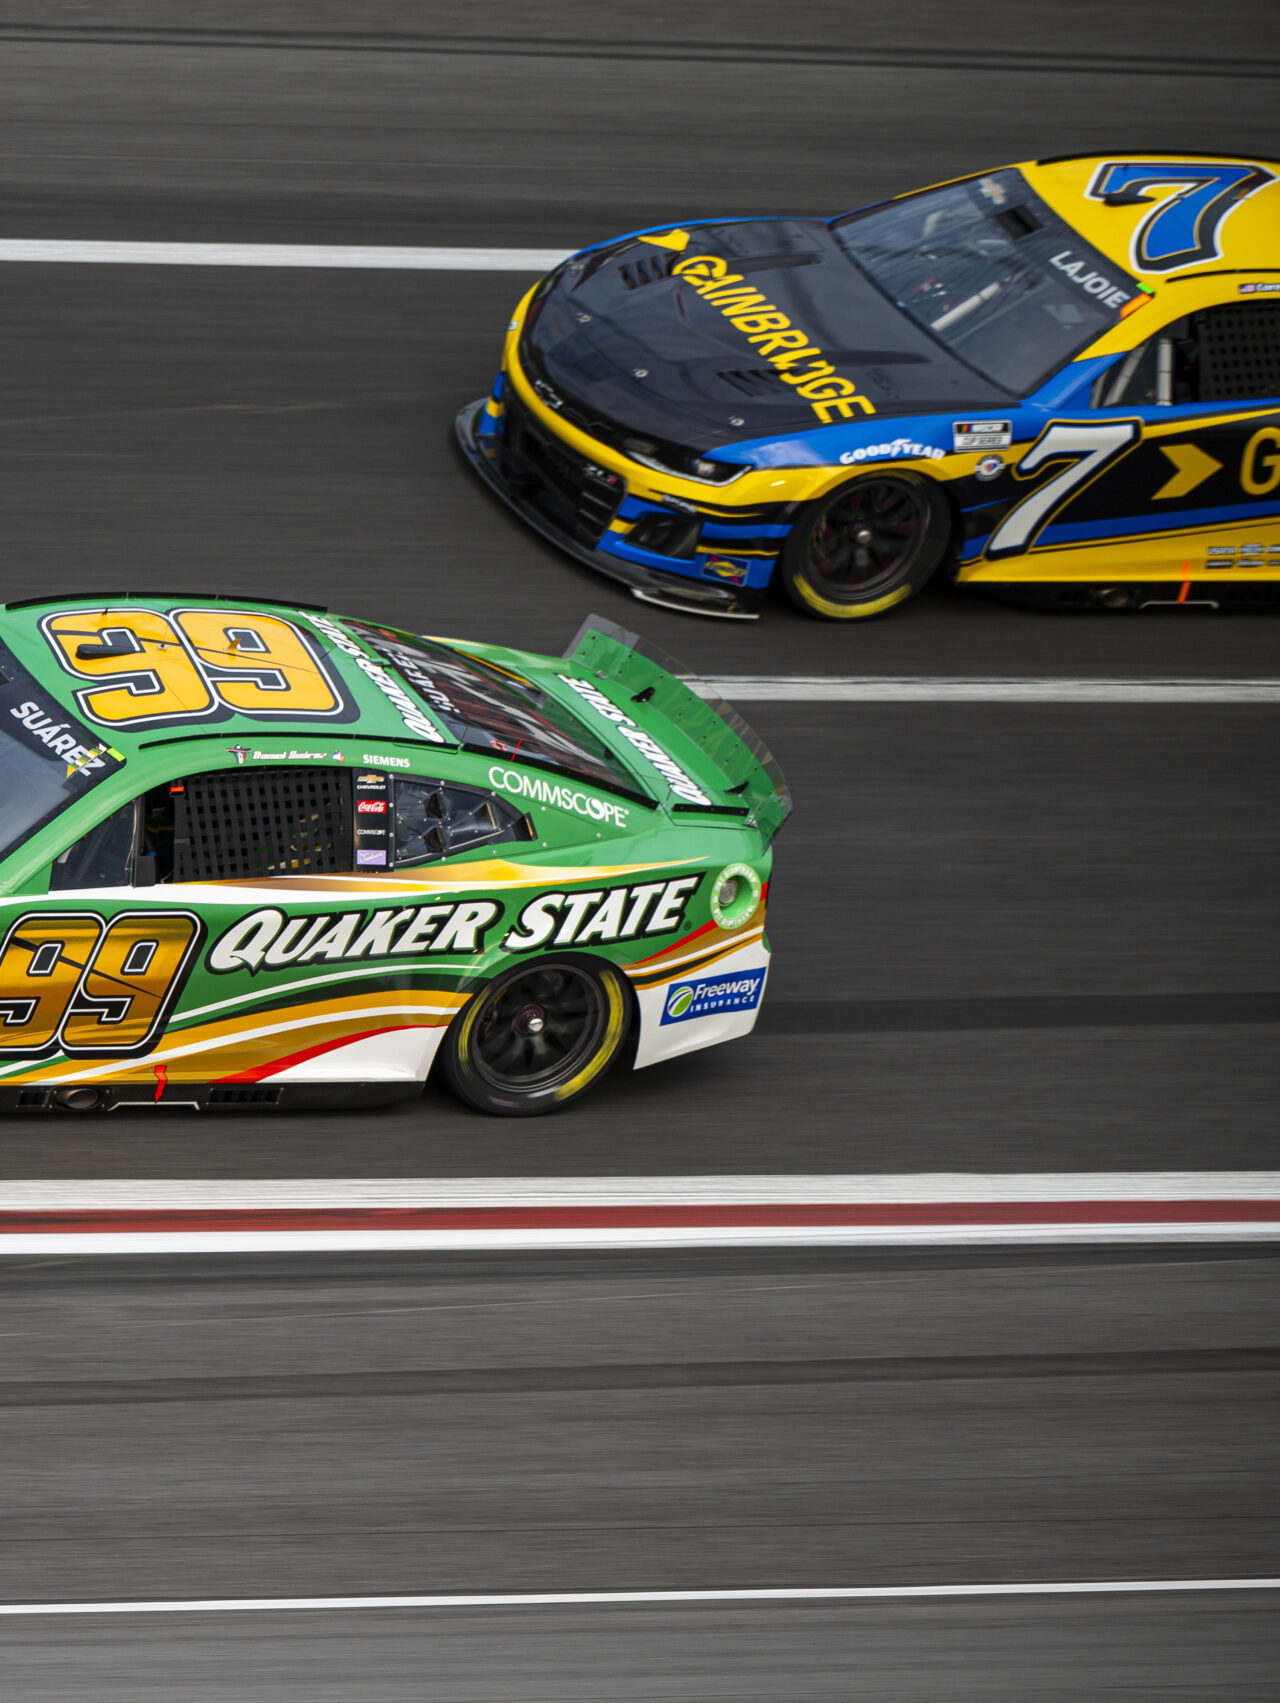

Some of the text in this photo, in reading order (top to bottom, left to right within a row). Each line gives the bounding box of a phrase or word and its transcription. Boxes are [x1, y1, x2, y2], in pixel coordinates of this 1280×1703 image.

[1084, 160, 1280, 274] 7
[1049, 251, 1130, 309] LAJOIE
[672, 255, 876, 424] GAINBRIDGE
[839, 438, 946, 464] GOODYEAR
[985, 420, 1140, 556] 7
[40, 607, 345, 727] 99
[9, 701, 106, 776] SUÁREZ
[362, 754, 411, 768] SIEMENS
[210, 876, 699, 972] QUAKER STATE
[689, 995, 756, 1013] INSURANCE
[693, 977, 761, 1001] Freeway
